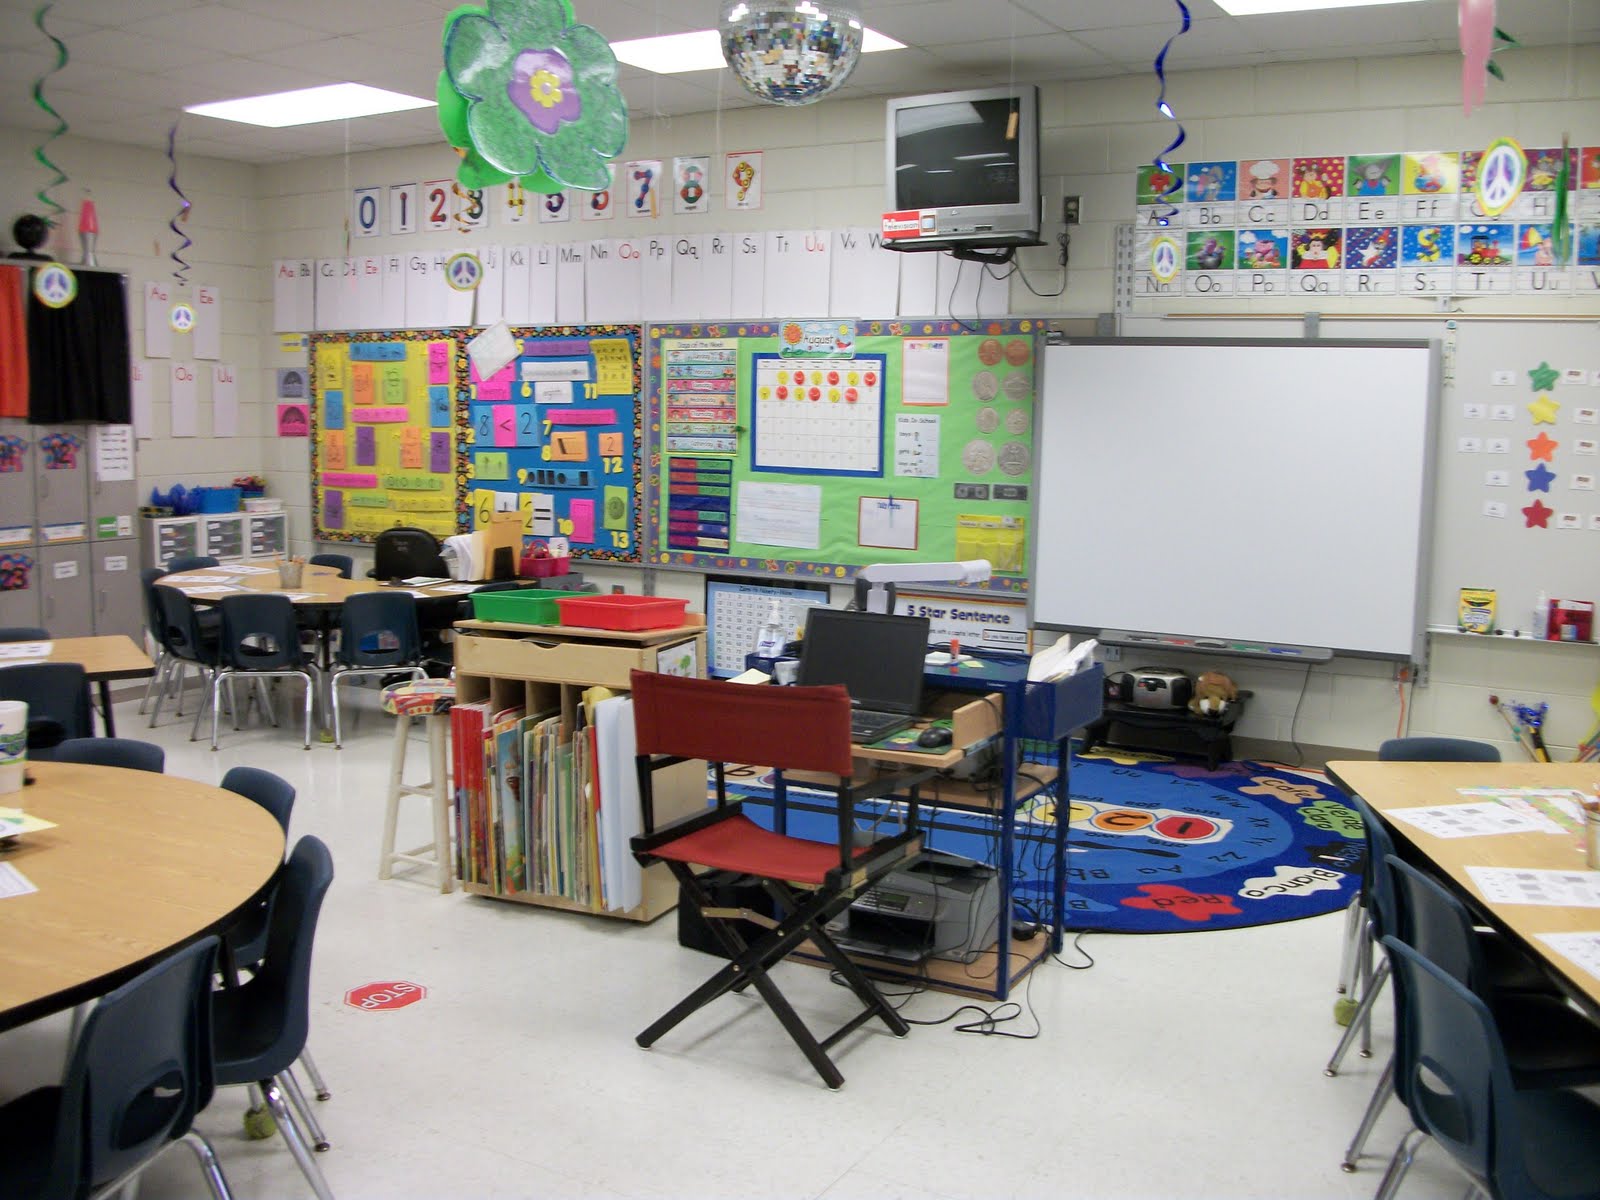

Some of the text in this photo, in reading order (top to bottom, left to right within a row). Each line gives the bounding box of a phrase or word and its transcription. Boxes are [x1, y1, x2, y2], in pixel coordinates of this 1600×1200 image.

[360, 196, 376, 228] 0
[400, 192, 408, 226] 1
[430, 188, 447, 222] 2
[467, 189, 484, 220] 3
[508, 182, 525, 216] 4
[634, 168, 654, 209] 7
[681, 165, 704, 204] 8
[733, 160, 755, 202] 9
[1199, 207, 1221, 225] Bb
[1248, 205, 1275, 224] Cc
[1302, 203, 1329, 222] Dd
[1358, 202, 1384, 220] Ee
[1416, 200, 1438, 218] Ff
[560, 248, 581, 264] Mm
[590, 244, 608, 260] Nn
[618, 243, 640, 260] Oo
[650, 240, 664, 260] Pp
[676, 239, 699, 260] Qq
[712, 238, 724, 255] Rr
[742, 237, 757, 254] Ss
[776, 235, 789, 254] Tt
[804, 234, 824, 252] Uu
[840, 232, 857, 250] Vv
[1146, 271, 1560, 294] Nn Oo Pp Qq Rr Ss Tt Uu
[199, 289, 214, 304] Ee
[803, 335, 835, 348] August
[175, 366, 193, 382] Oo
[218, 367, 232, 383] Uu
[469, 384, 476, 400] 1
[520, 382, 532, 398] 6
[583, 383, 598, 400] 11
[480, 414, 490, 437] 8
[520, 412, 532, 436] 2
[542, 419, 553, 436] 7
[464, 428, 476, 446] 2
[606, 436, 614, 452] 2
[541, 444, 552, 462] 8
[466, 463, 476, 480] 3
[602, 456, 624, 474] 12
[516, 468, 528, 485] 9
[479, 496, 490, 524] 6
[558, 518, 574, 536] 10
[610, 531, 630, 549] 13
[919, 606, 947, 619] Star
[950, 608, 1010, 624] Sentence
[1261, 778, 1314, 800] Cafe
[1103, 812, 1148, 827] 2
[1182, 806, 1222, 816] uno
[1177, 821, 1193, 834] 1
[1146, 838, 1189, 849] one
[1136, 864, 1183, 874] Aa
[1246, 868, 1339, 898] Blanco
[1152, 894, 1224, 908] Red
[360, 983, 417, 1008] STOP
